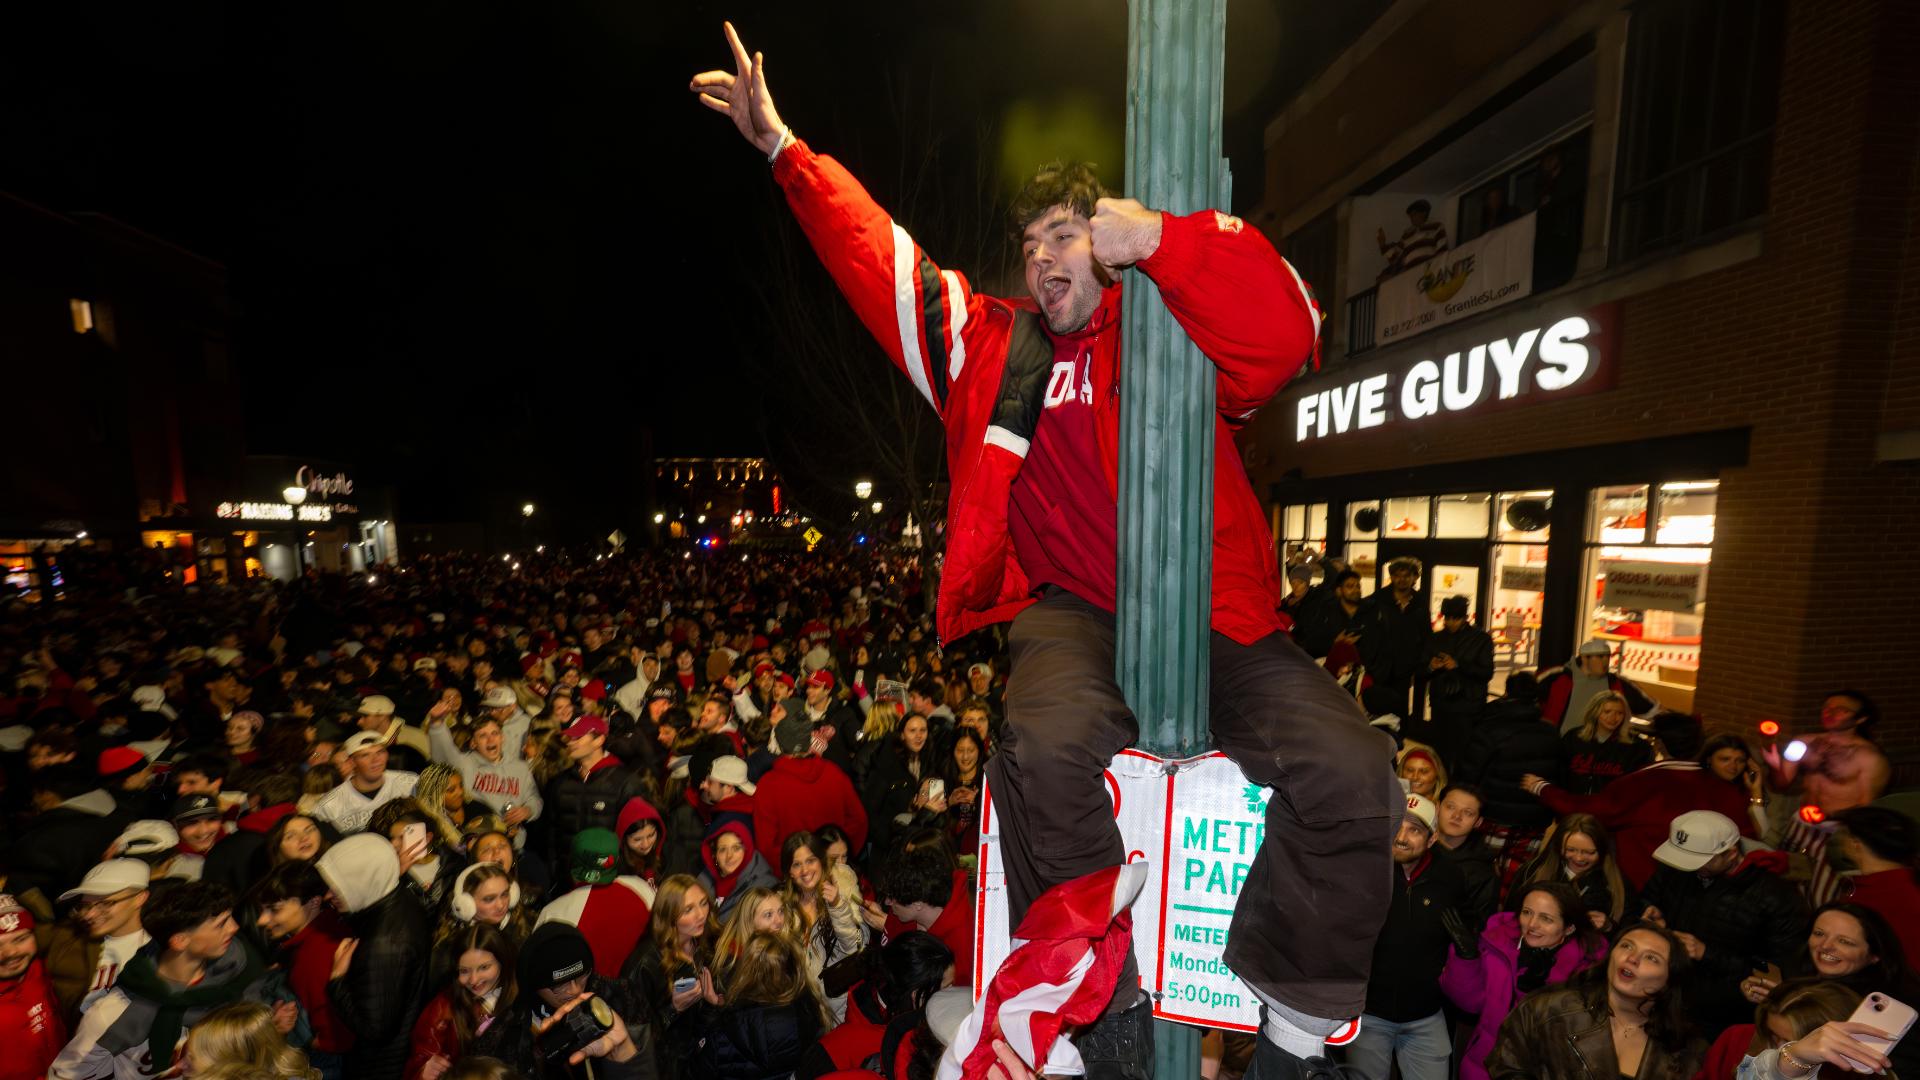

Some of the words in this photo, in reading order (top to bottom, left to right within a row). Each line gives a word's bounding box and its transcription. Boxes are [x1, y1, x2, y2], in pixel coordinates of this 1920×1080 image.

[1417, 253, 1475, 295] GRANITE
[1445, 282, 1520, 315] GraniteSL.com
[1296, 373, 1388, 442] FIVE
[1400, 316, 1591, 420] GUYS
[1609, 571, 1650, 585] ORDER
[1654, 573, 1698, 588] ONLINE
[1168, 981, 1240, 1009] 5:00pm
